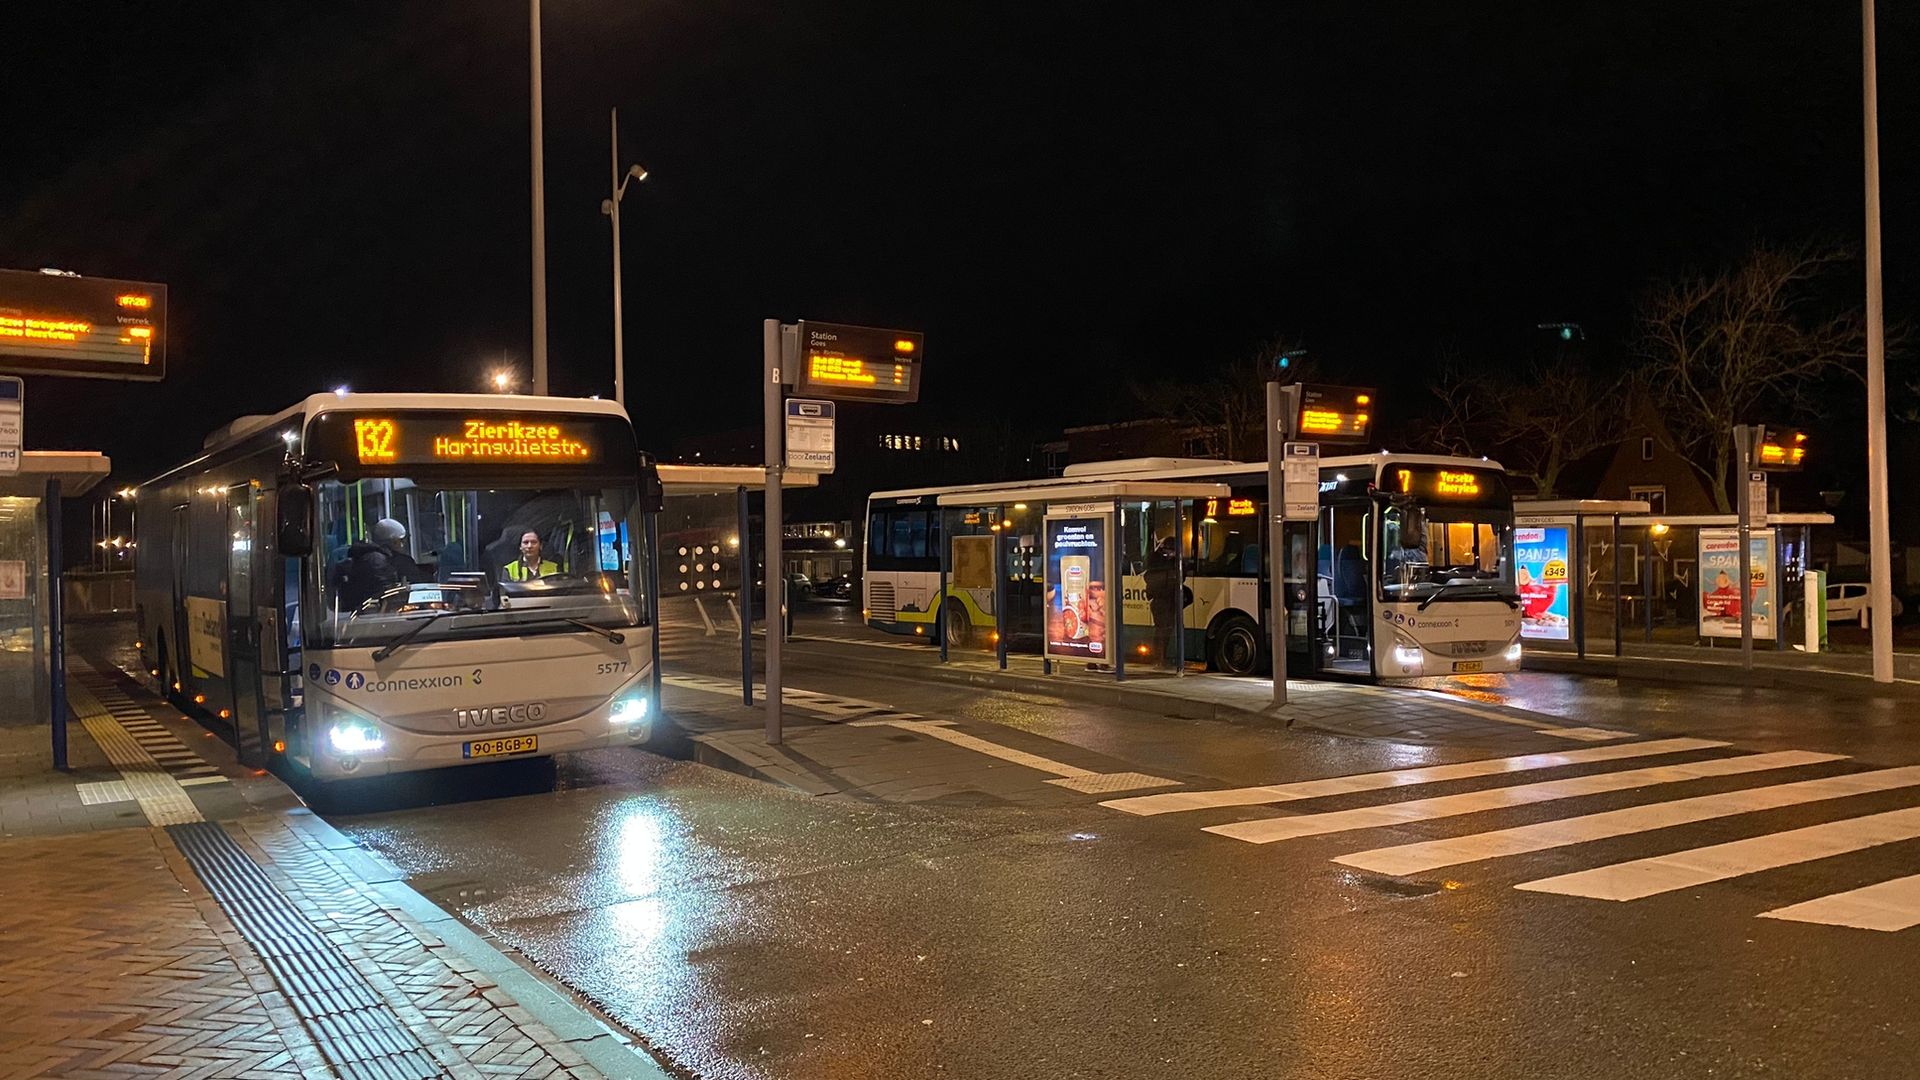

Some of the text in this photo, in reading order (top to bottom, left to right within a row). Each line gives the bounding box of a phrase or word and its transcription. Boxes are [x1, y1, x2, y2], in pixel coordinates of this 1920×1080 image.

[117, 315, 150, 326] Vertrek
[811, 331, 837, 341] Station
[772, 368, 780, 383] B
[355, 419, 559, 457] 132 Zierikzee
[436, 438, 589, 455] Haringvlietstr.
[1515, 533, 1539, 541] rendon
[1517, 548, 1560, 561] PANJE
[1545, 567, 1566, 577] €349
[597, 662, 628, 675] 5577
[366, 675, 462, 693] connexxion
[456, 703, 547, 729] IVECO
[474, 737, 533, 754] 90-BGB-9
